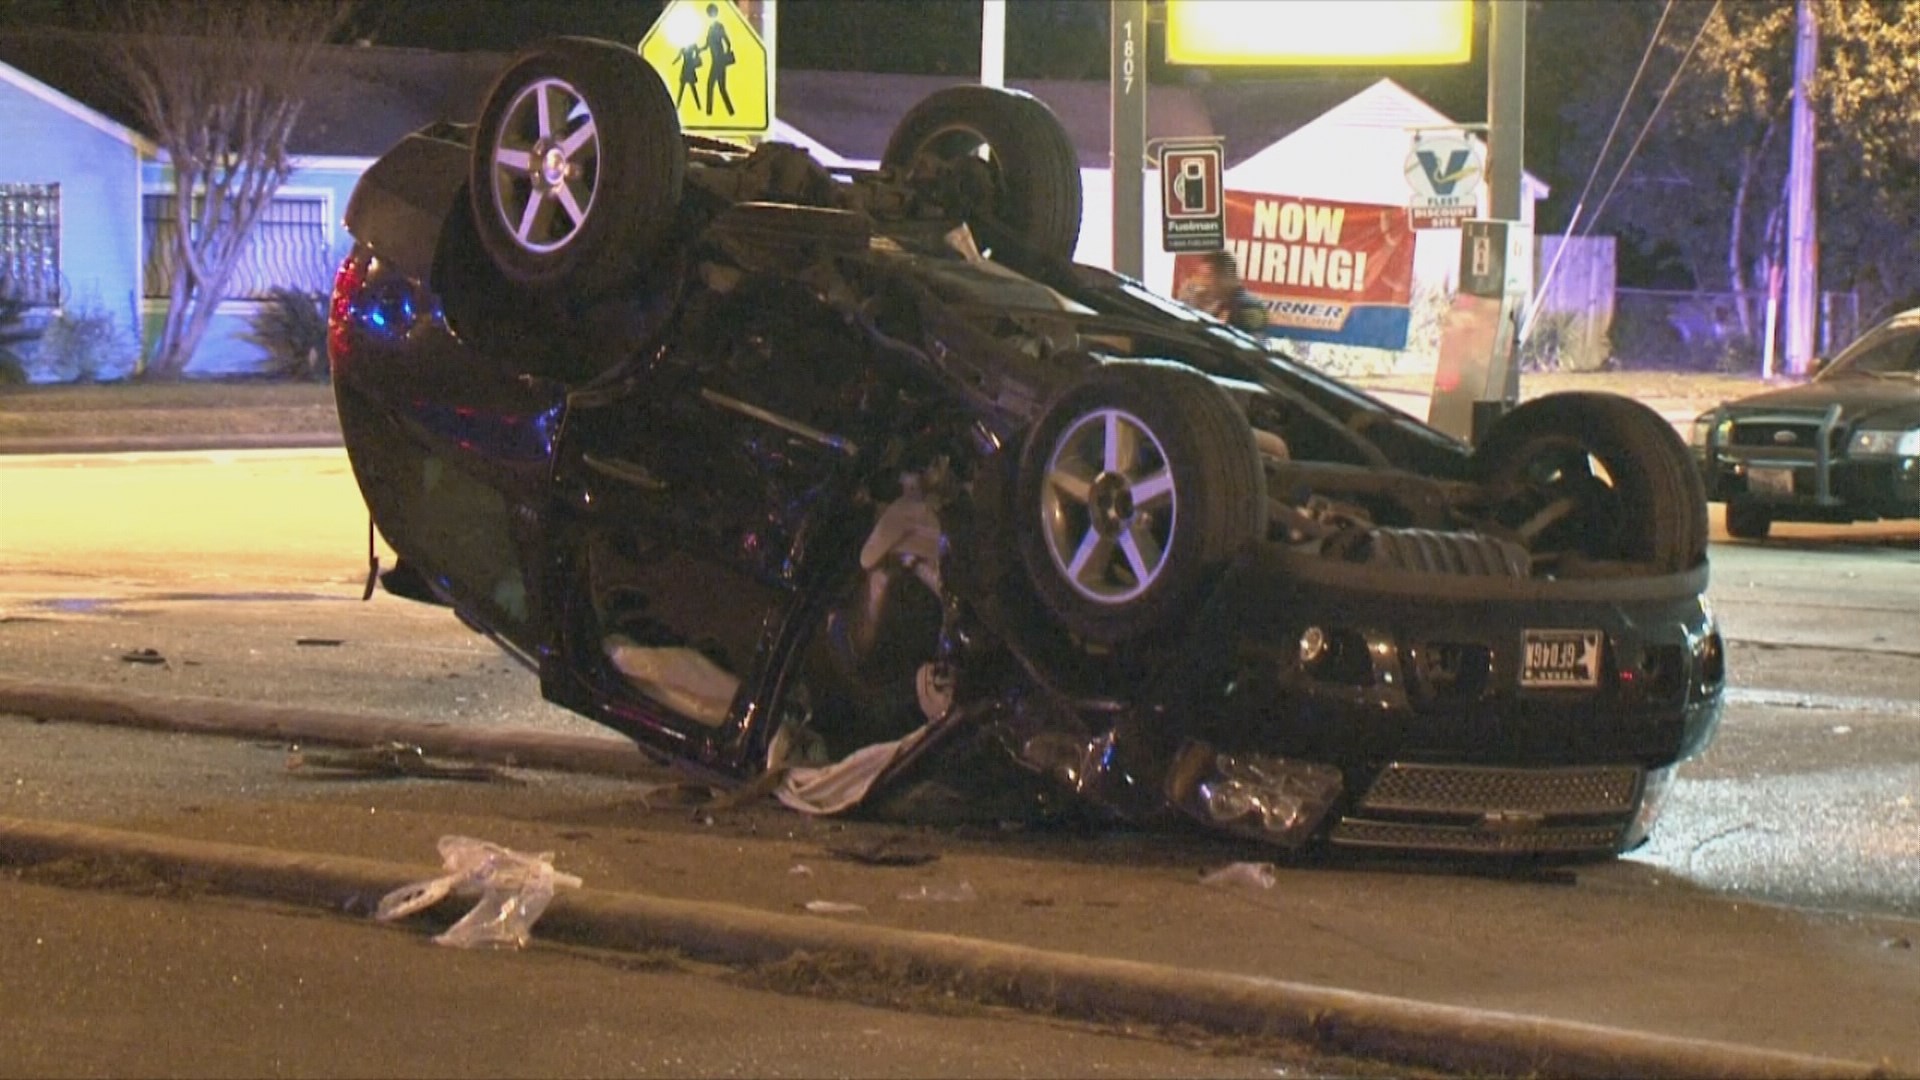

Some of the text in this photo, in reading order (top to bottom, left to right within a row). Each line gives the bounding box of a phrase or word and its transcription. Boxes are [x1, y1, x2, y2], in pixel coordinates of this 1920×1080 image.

[1123, 20, 1134, 95] 1807
[1427, 197, 1459, 206] FLEET
[1414, 207, 1474, 217] DISCOUNT
[1168, 220, 1219, 232] Fuelman
[1253, 199, 1345, 246] NOW
[1431, 218, 1457, 228] SITE
[1476, 238, 1486, 272] AIR
[1226, 239, 1368, 293] HIRING!
[1266, 300, 1343, 318] ORNER
